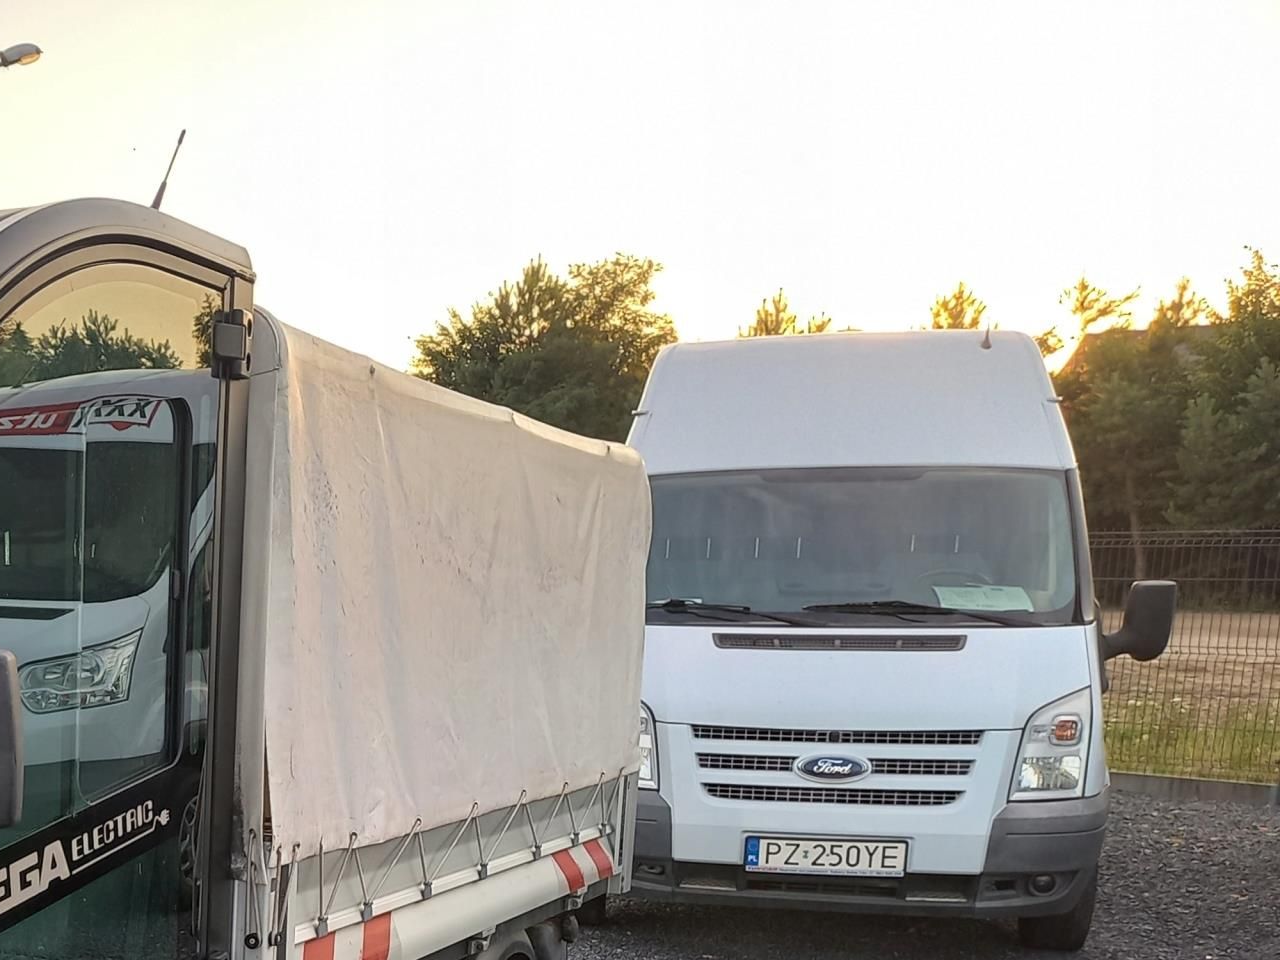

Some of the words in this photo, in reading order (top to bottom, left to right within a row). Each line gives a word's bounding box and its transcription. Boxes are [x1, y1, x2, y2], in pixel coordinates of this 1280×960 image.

[813, 758, 853, 774] Ford
[72, 800, 154, 861] ELECTRIC
[747, 855, 758, 863] PL
[765, 842, 800, 865] PZ
[811, 844, 899, 868] 250YE
